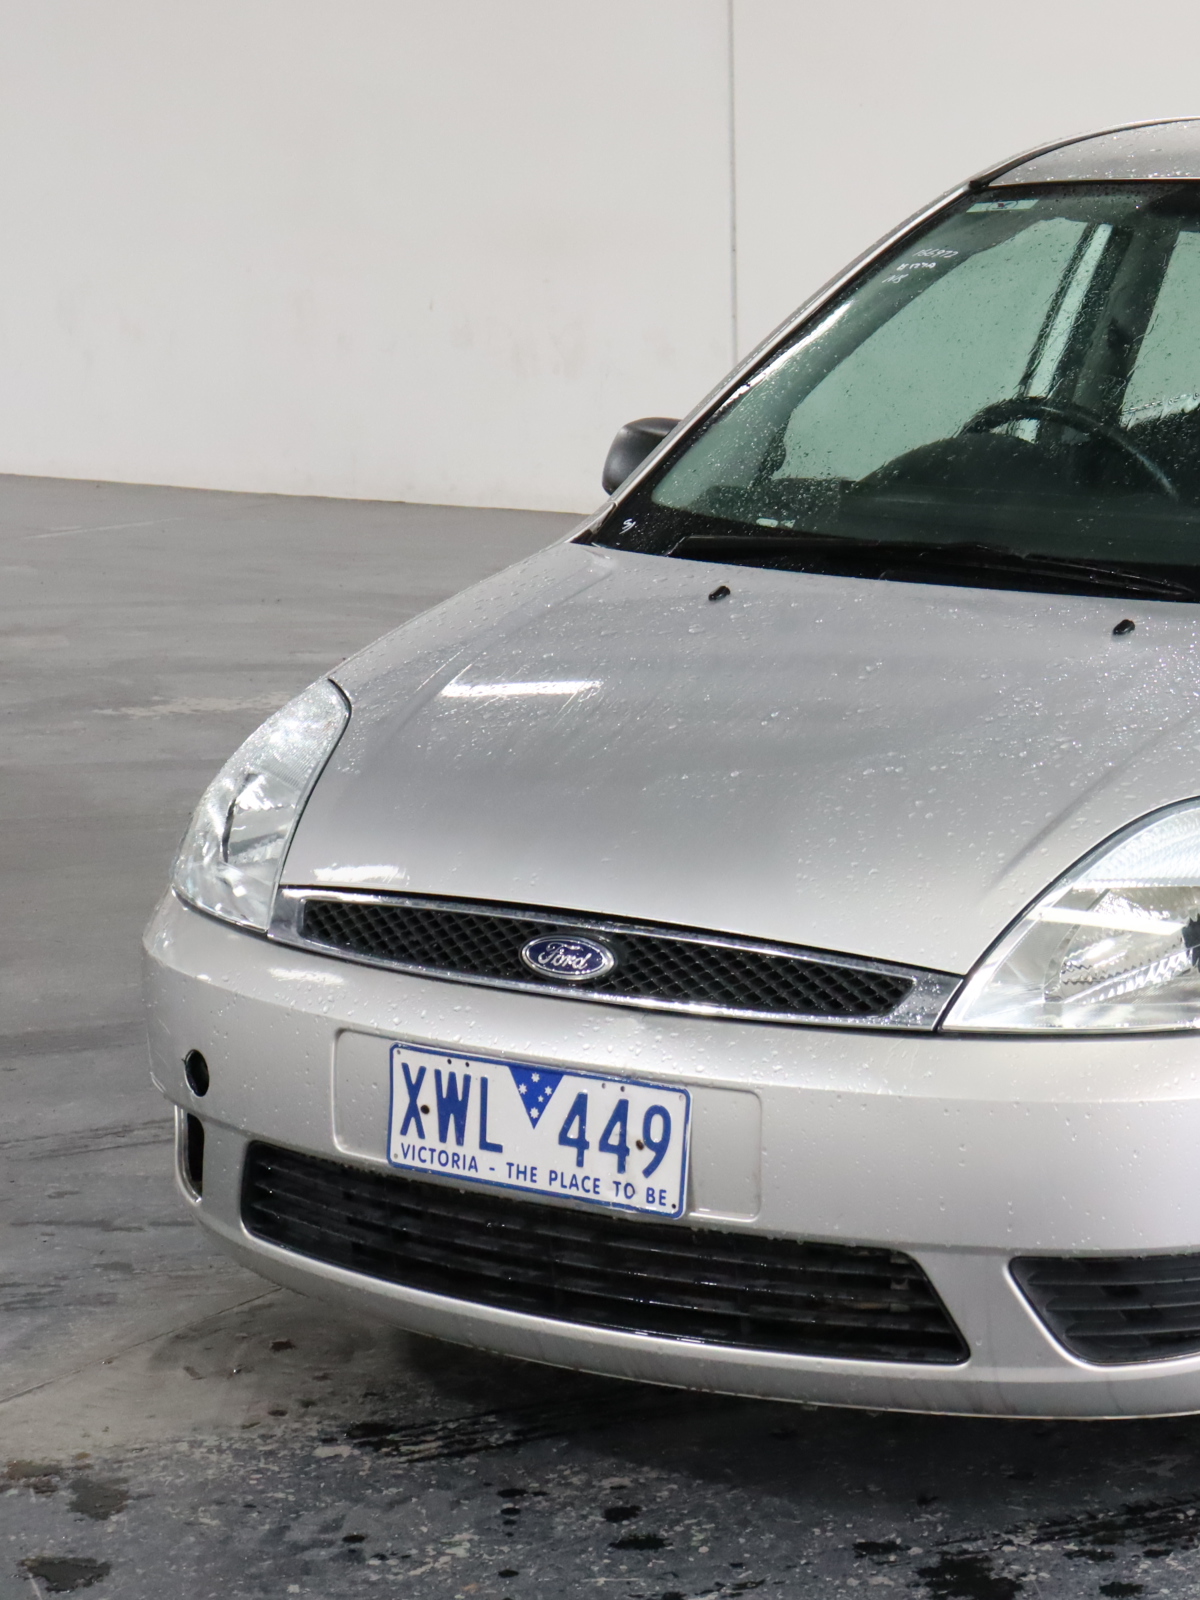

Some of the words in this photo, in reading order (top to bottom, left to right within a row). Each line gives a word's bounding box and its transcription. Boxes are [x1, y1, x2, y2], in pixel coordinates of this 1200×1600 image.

[538, 942, 592, 969] Ford
[399, 1062, 503, 1153] XWL
[558, 1091, 672, 1179] 449
[400, 1142, 478, 1173] VICTORIA
[506, 1162, 537, 1183] THE
[549, 1170, 600, 1195] PLACE
[612, 1181, 636, 1200] TO
[645, 1187, 667, 1207] BE
